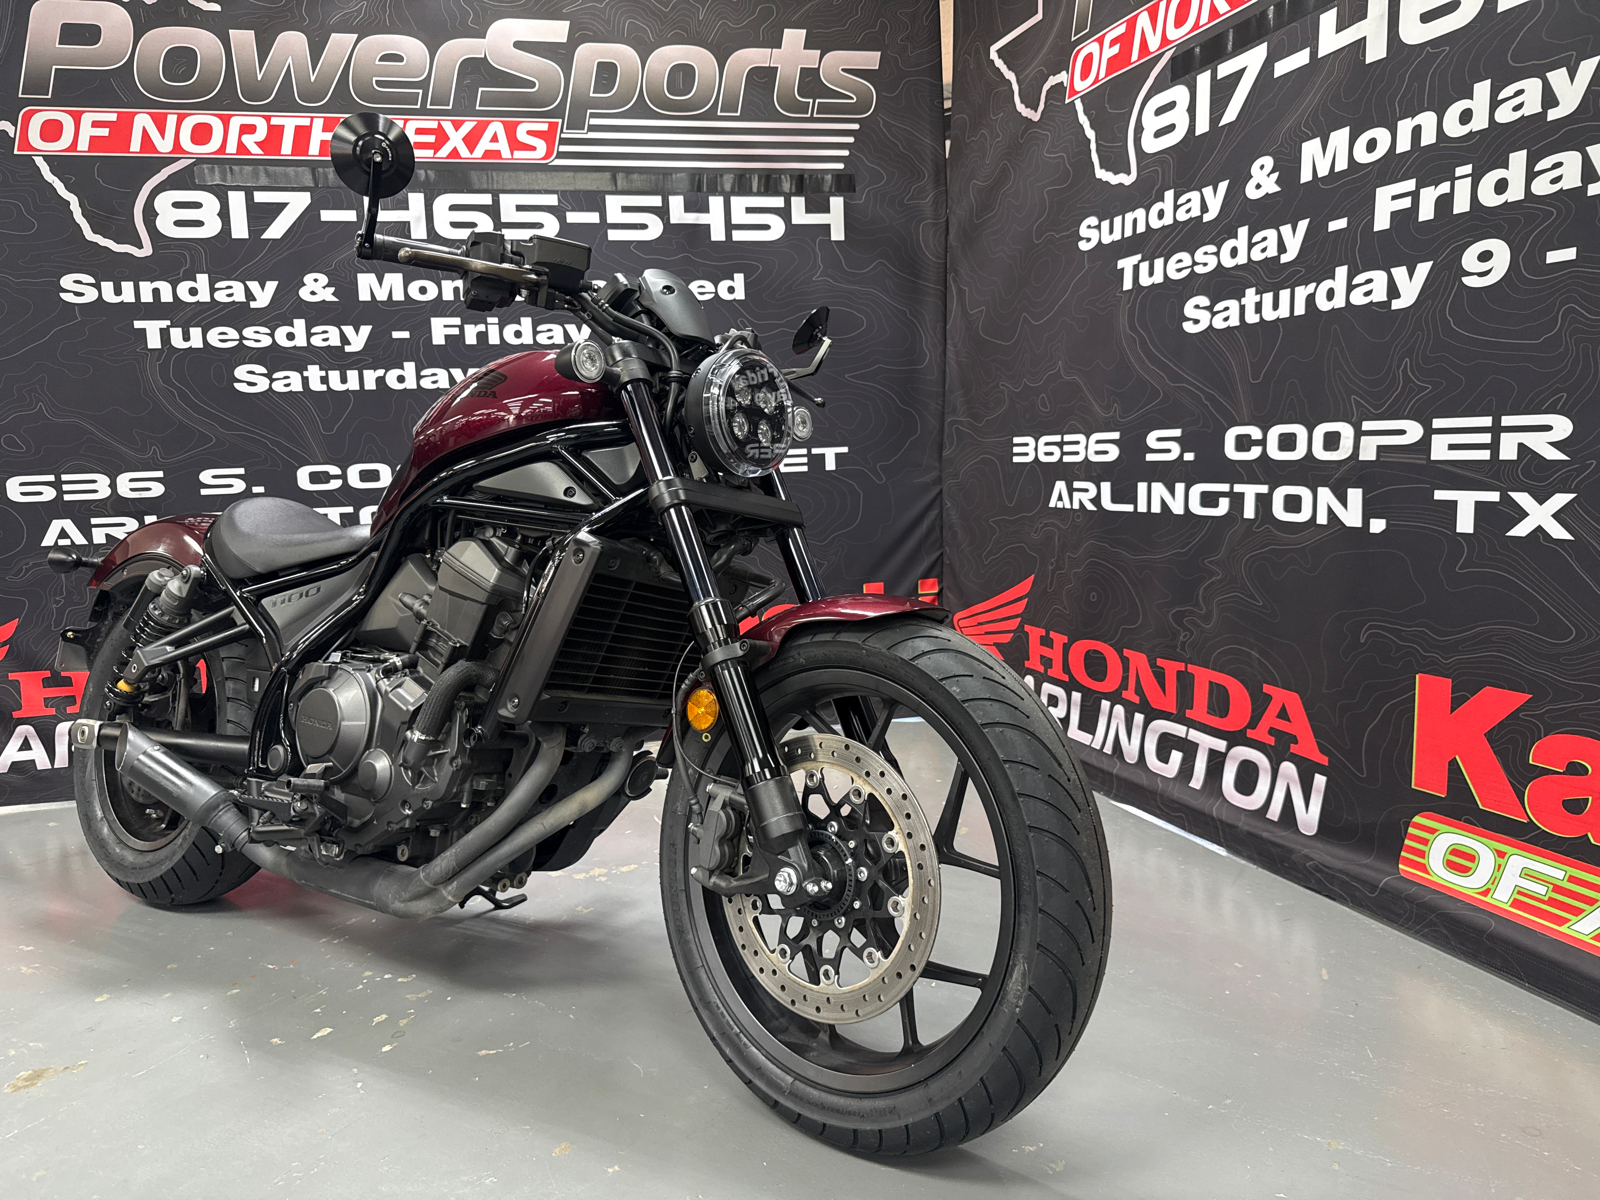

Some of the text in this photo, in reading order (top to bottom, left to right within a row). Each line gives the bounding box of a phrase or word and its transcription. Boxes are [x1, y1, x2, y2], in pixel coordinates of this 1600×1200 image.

[18, 0, 881, 134] PowerSports
[1074, 22, 1127, 91] OF
[27, 111, 110, 152] OF
[1077, 55, 1600, 252] Sunday & Monday
[154, 190, 845, 241] 817-465-5454
[1116, 216, 1309, 292] Tuesday
[59, 273, 278, 308] Sunday
[299, 272, 339, 302] &
[1181, 259, 1433, 334] Saturday
[1461, 239, 1510, 288] 9
[134, 319, 372, 352] Tuesday
[1012, 413, 1573, 463] 3636 S. COOPER
[199, 467, 264, 495] S.
[1049, 480, 1577, 540] ARLINGTON, TX
[1024, 624, 1329, 765] HONDA
[1428, 831, 1567, 904] OF
